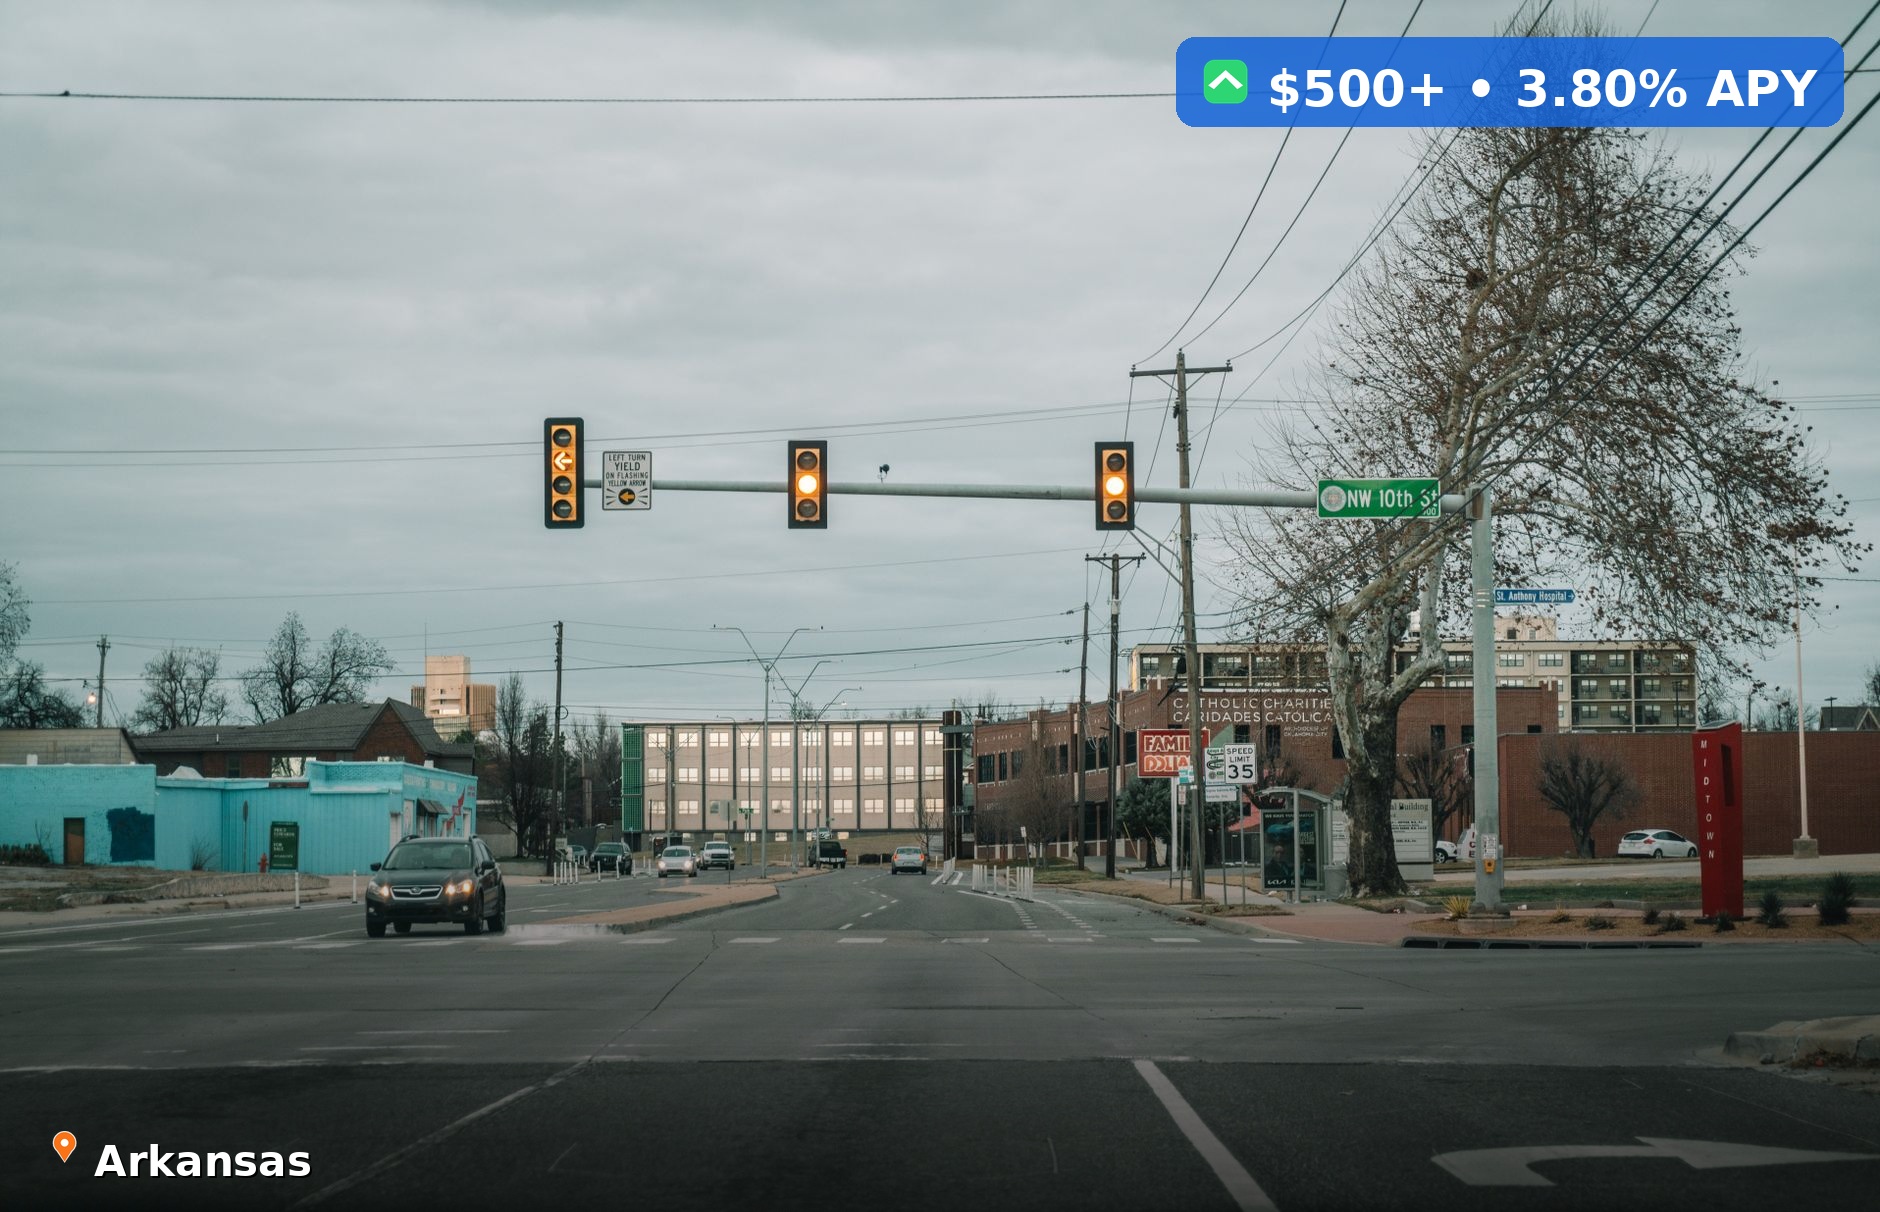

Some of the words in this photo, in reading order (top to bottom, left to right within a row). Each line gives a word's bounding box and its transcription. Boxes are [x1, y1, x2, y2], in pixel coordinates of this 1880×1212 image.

[614, 462, 640, 471] YIELD
[1347, 490, 1372, 508] NW
[1380, 489, 1413, 508] 10th
[1420, 488, 1438, 508] St
[1496, 591, 1506, 600] St.
[1508, 591, 1537, 603] Anthony
[1538, 592, 1567, 603] Hospital
[1173, 698, 1258, 709] CTHOLIC
[1263, 698, 1332, 709] CHARITIE
[1144, 736, 1190, 752] FAMIL
[1144, 755, 1190, 772] DOLLA
[1228, 764, 1254, 779] 35
[1399, 802, 1429, 812] Building
[1700, 740, 1714, 859] MIDTOWN
